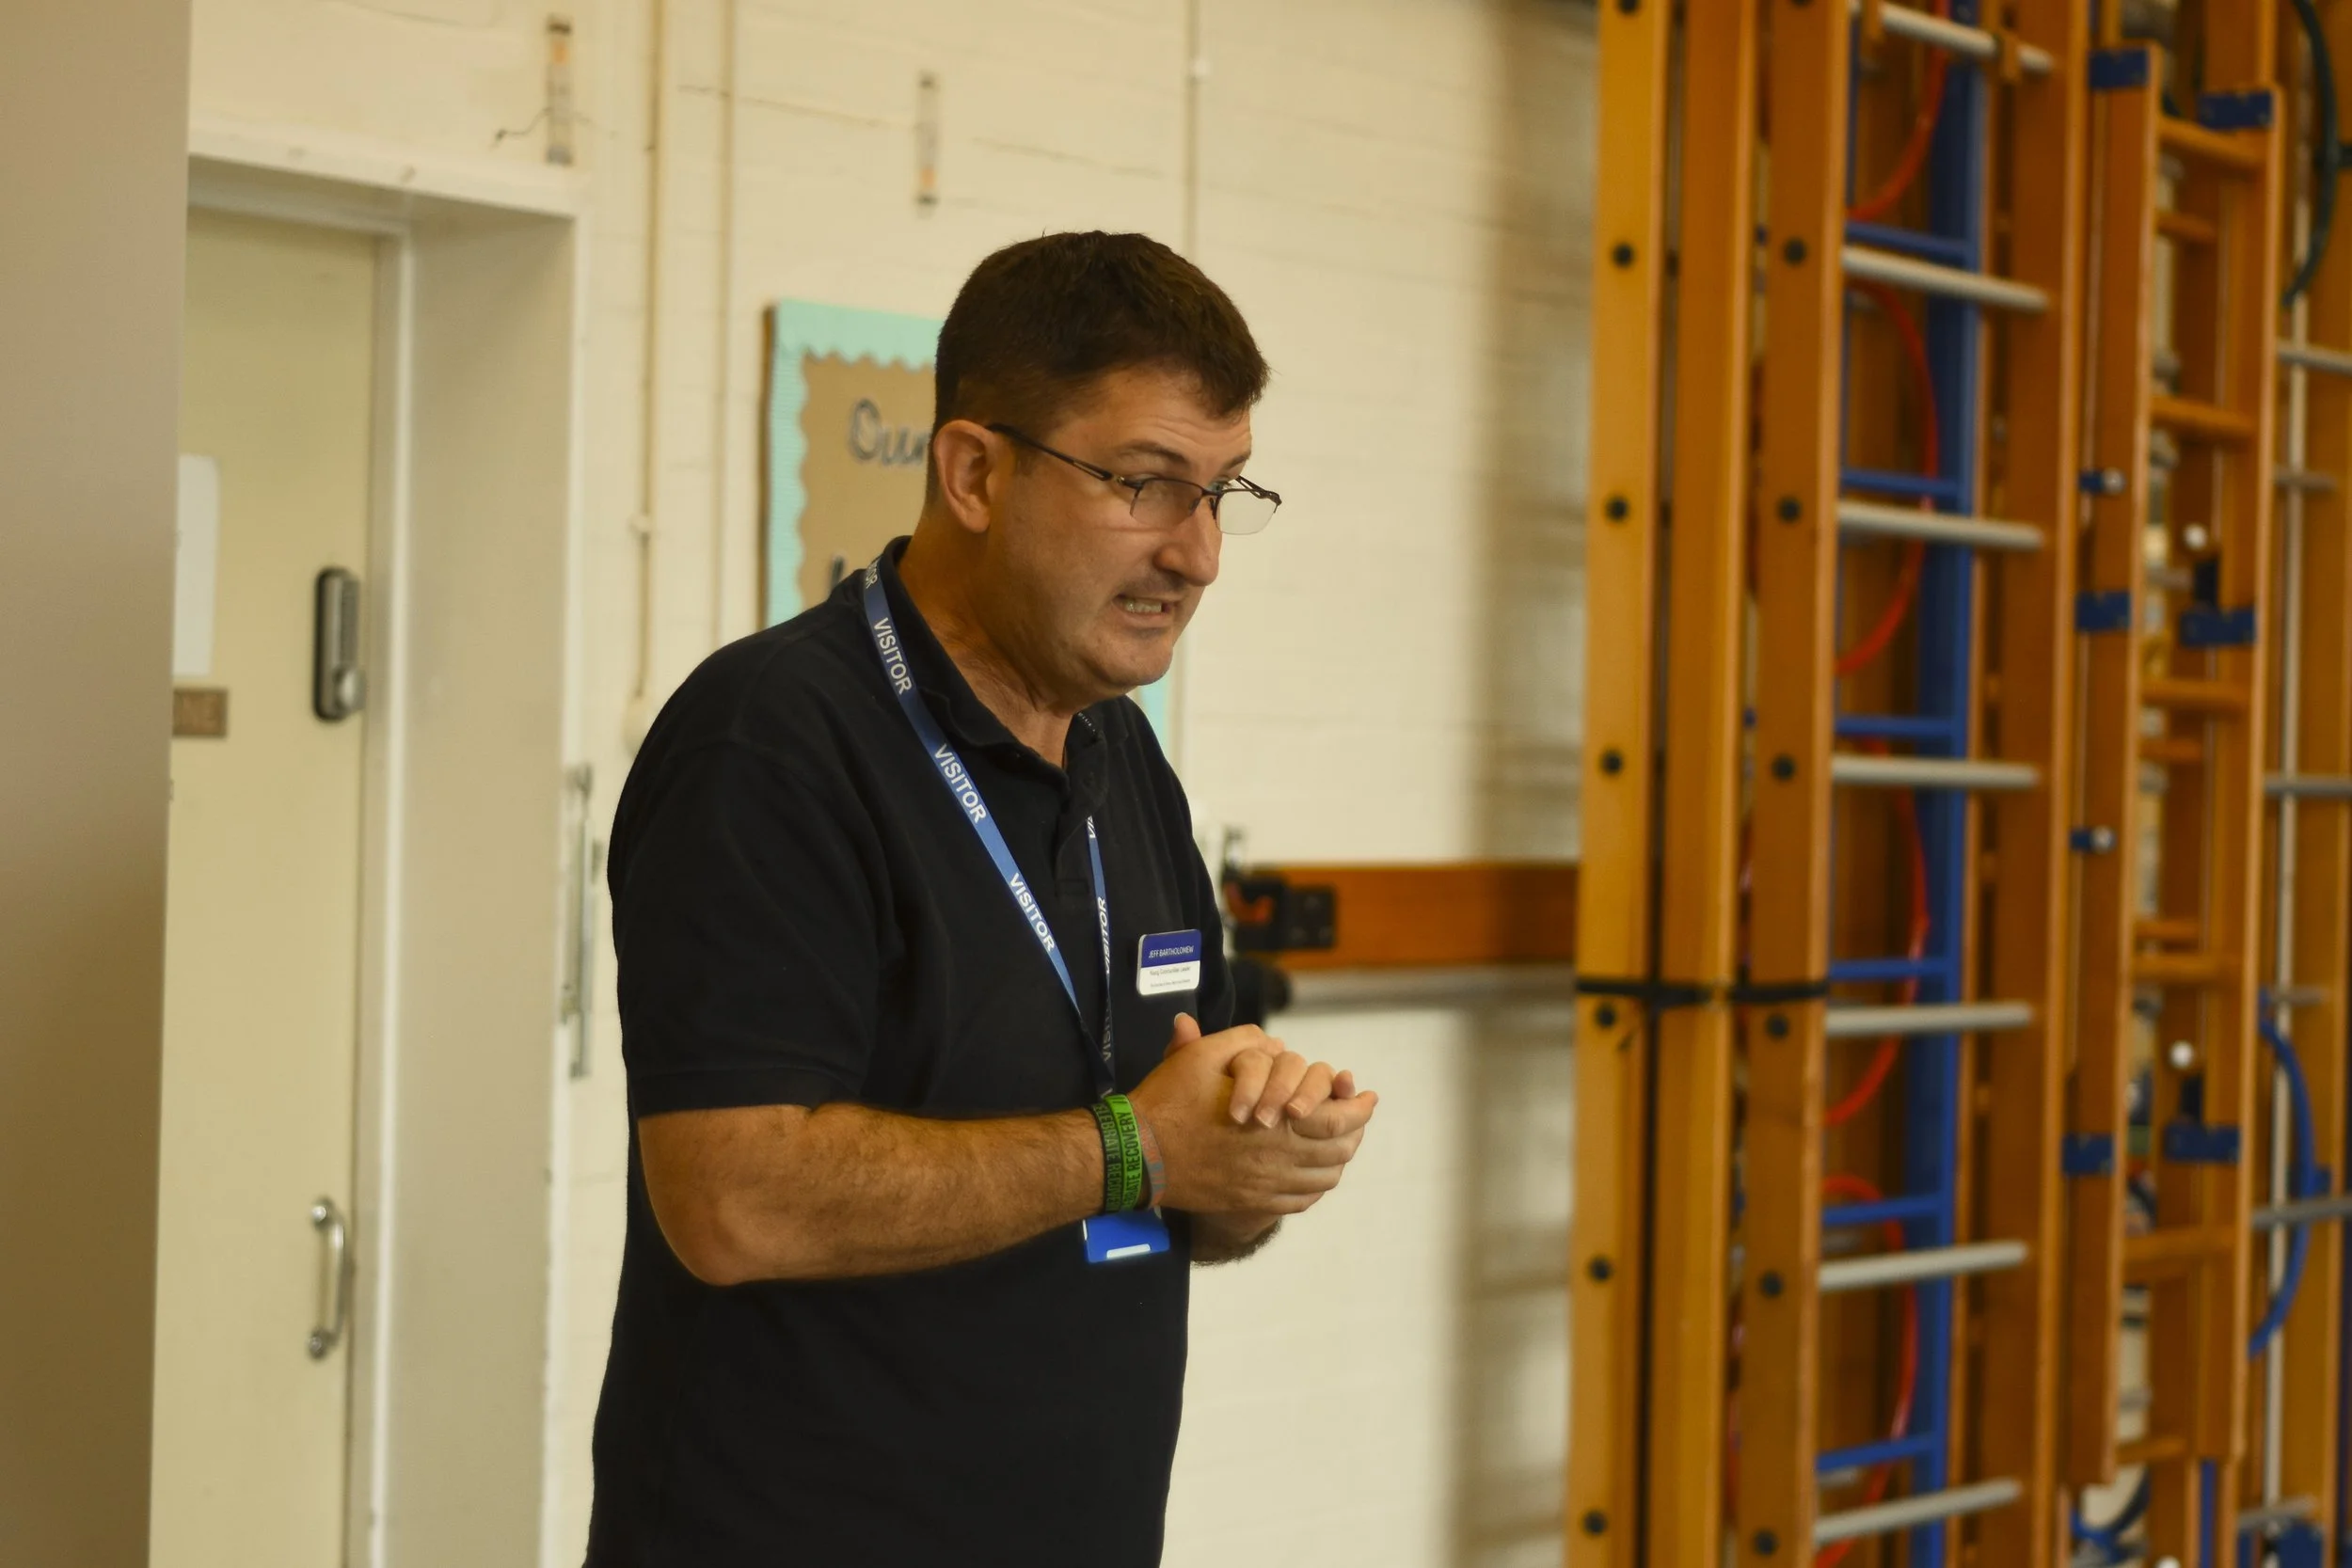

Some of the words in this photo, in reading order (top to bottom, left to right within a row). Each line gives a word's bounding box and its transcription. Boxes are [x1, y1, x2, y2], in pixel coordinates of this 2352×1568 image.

[873, 617, 913, 694] VISITOR
[934, 743, 987, 823] VISITOR
[1009, 872, 1055, 951] VISITOR
[1097, 896, 1110, 974] VISITOR
[1149, 949, 1159, 958] JEFF
[1159, 945, 1195, 957] BARTHOLOMEW
[1117, 1112, 1141, 1173] RECOVERY
